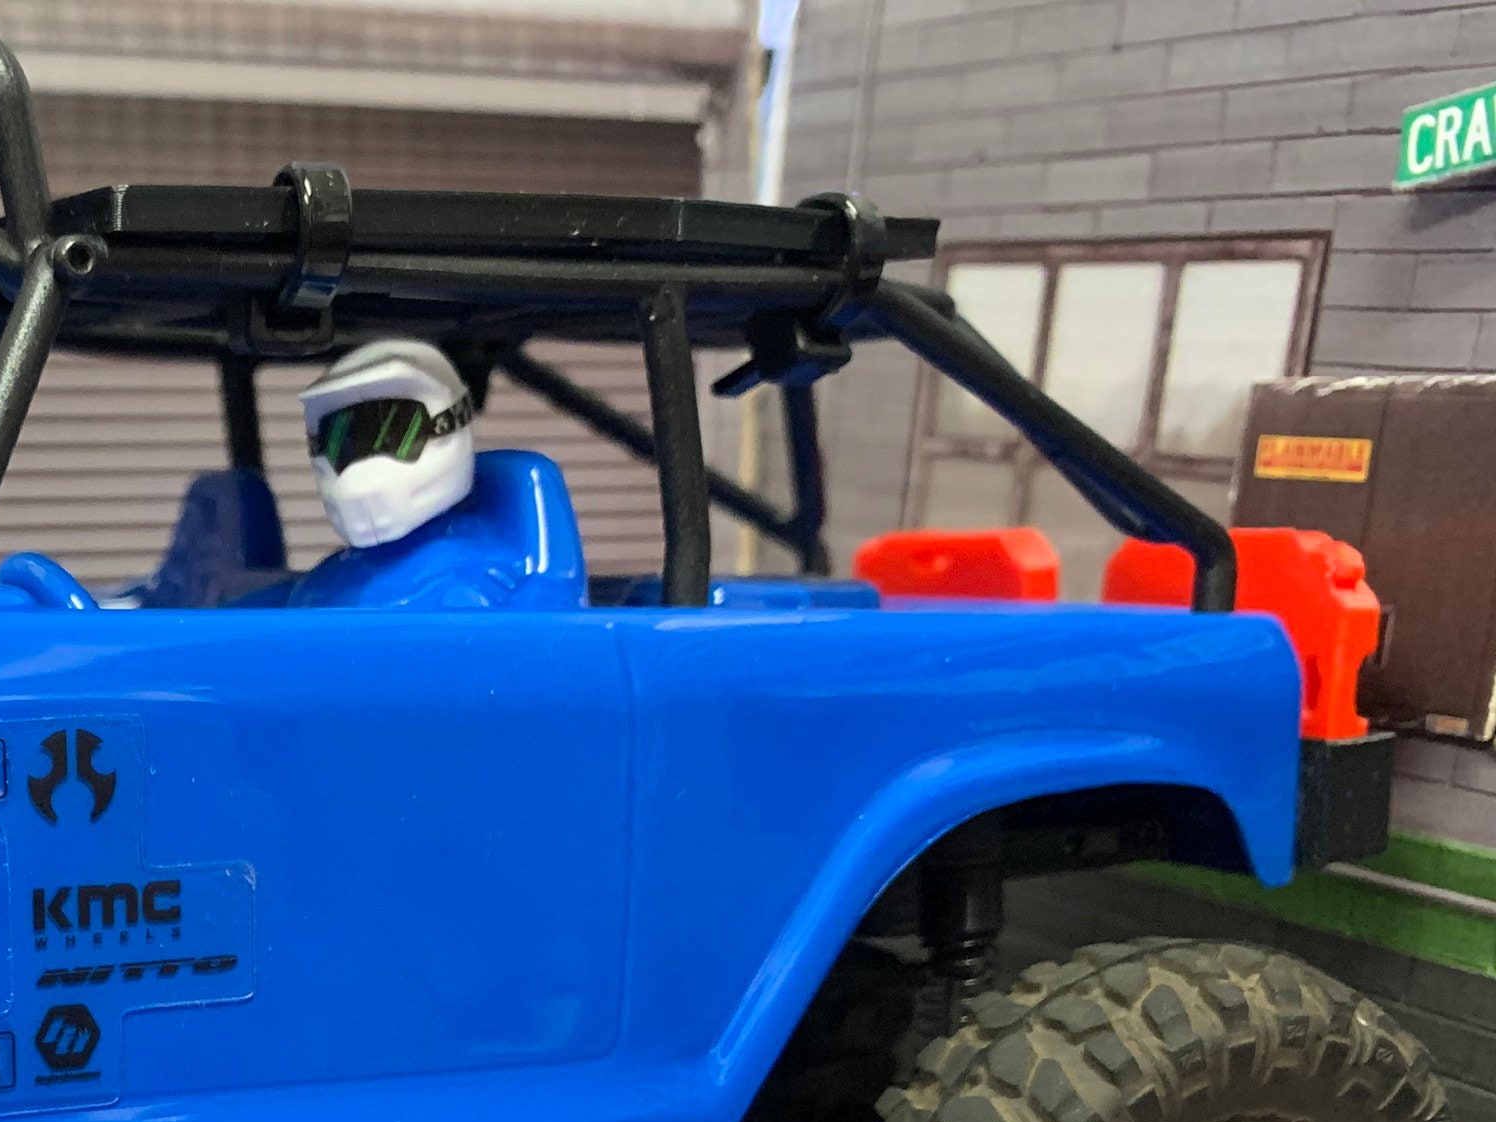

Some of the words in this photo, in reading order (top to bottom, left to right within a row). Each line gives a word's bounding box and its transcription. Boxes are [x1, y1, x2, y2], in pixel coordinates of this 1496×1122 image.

[1407, 94, 1496, 174] CRA
[32, 880, 182, 930] KMC
[34, 926, 182, 949] WHEELS
[36, 955, 238, 988] NITTO
